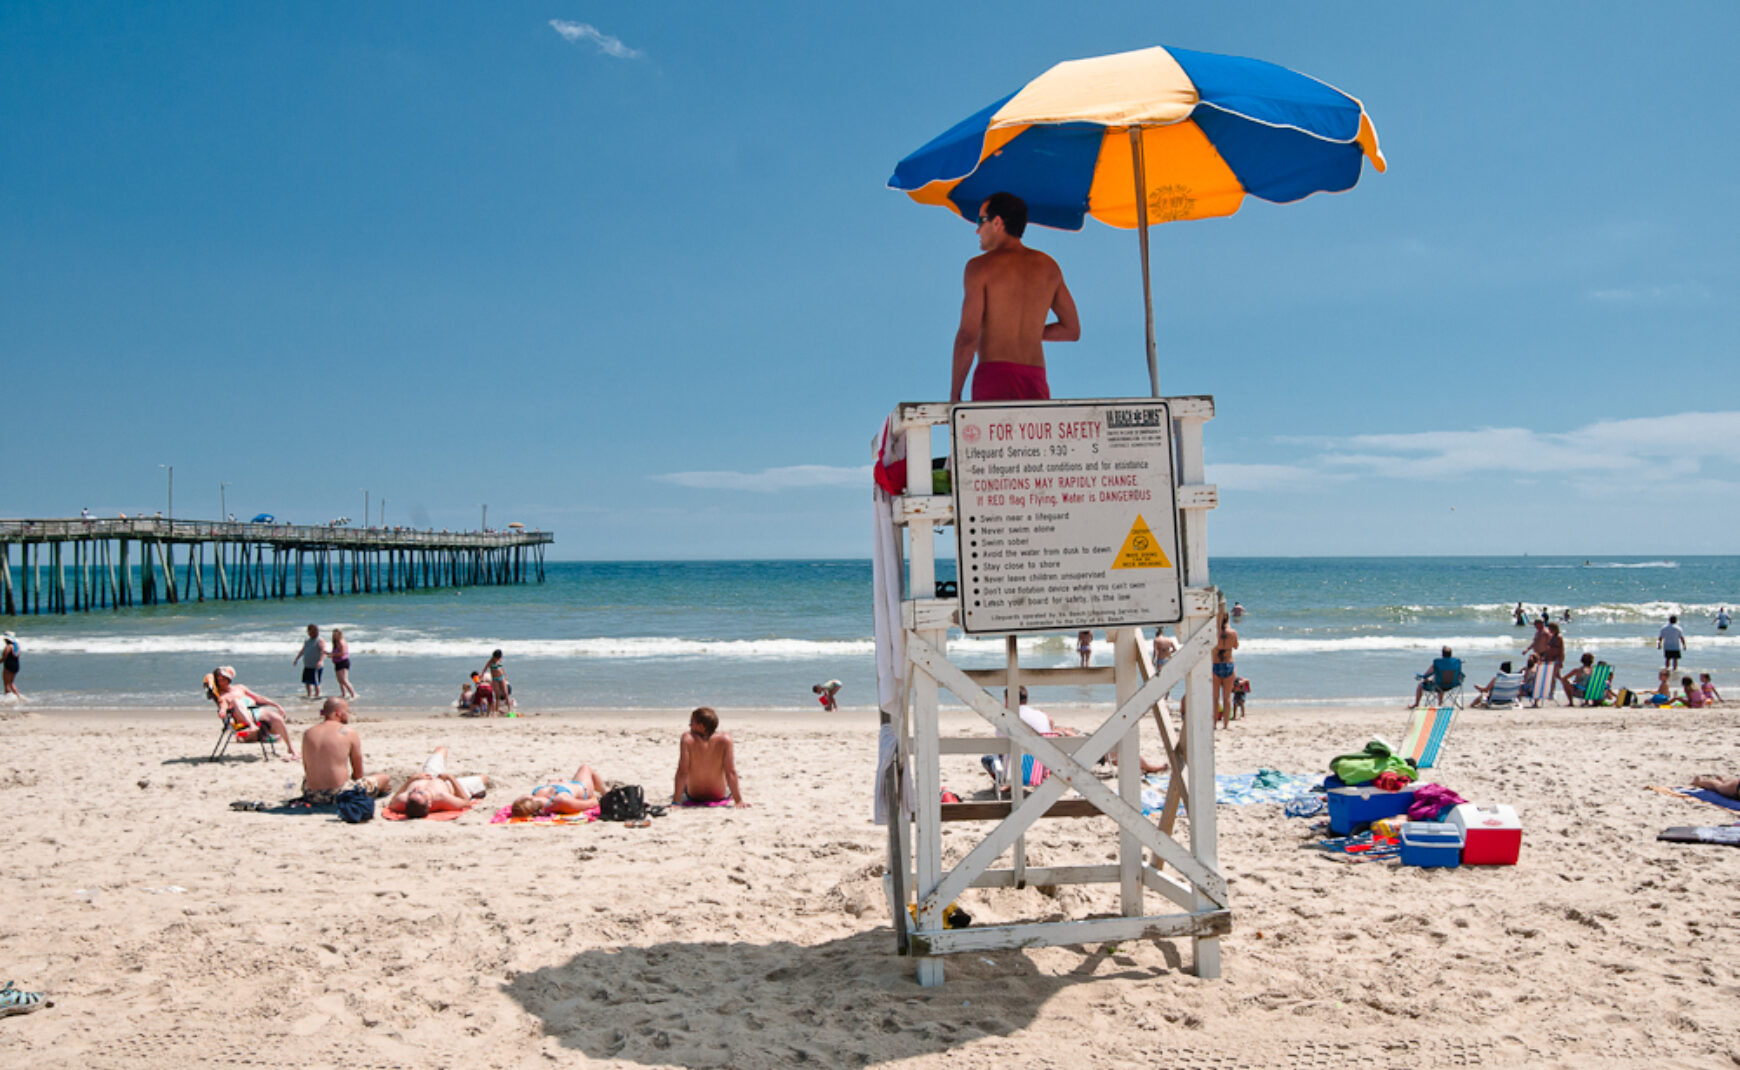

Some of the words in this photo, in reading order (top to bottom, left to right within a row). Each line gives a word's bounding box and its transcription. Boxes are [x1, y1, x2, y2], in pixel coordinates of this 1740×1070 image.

[989, 424, 1012, 440] FOR
[1019, 423, 1051, 439] YOUR
[1059, 422, 1100, 439] SAFETY
[966, 448, 1003, 461] Lifeguard
[1008, 446, 1040, 457] Services
[989, 464, 1020, 475] lifeguard
[1024, 464, 1044, 472] about
[1047, 463, 1082, 472] conditions
[1086, 462, 1098, 470] and
[1101, 462, 1111, 470] for
[1115, 461, 1148, 469] assistance
[974, 478, 1030, 491] CONDITIONS
[1035, 478, 1052, 488] MAY
[1059, 477, 1096, 488] RAPIDLY
[1102, 475, 1137, 486] CHANGE
[988, 495, 1004, 506] RED
[1009, 495, 1025, 507] flag
[1062, 494, 1084, 503] Water
[1089, 494, 1096, 502] is
[1100, 490, 1151, 502] DANGEROUS
[980, 515, 1002, 523] Swim
[1035, 513, 1069, 522] lifeguard
[982, 539, 1004, 547] Swim
[983, 563, 1000, 571] Stay
[1005, 562, 1024, 570] close
[1061, 571, 1105, 580] unsupervised
